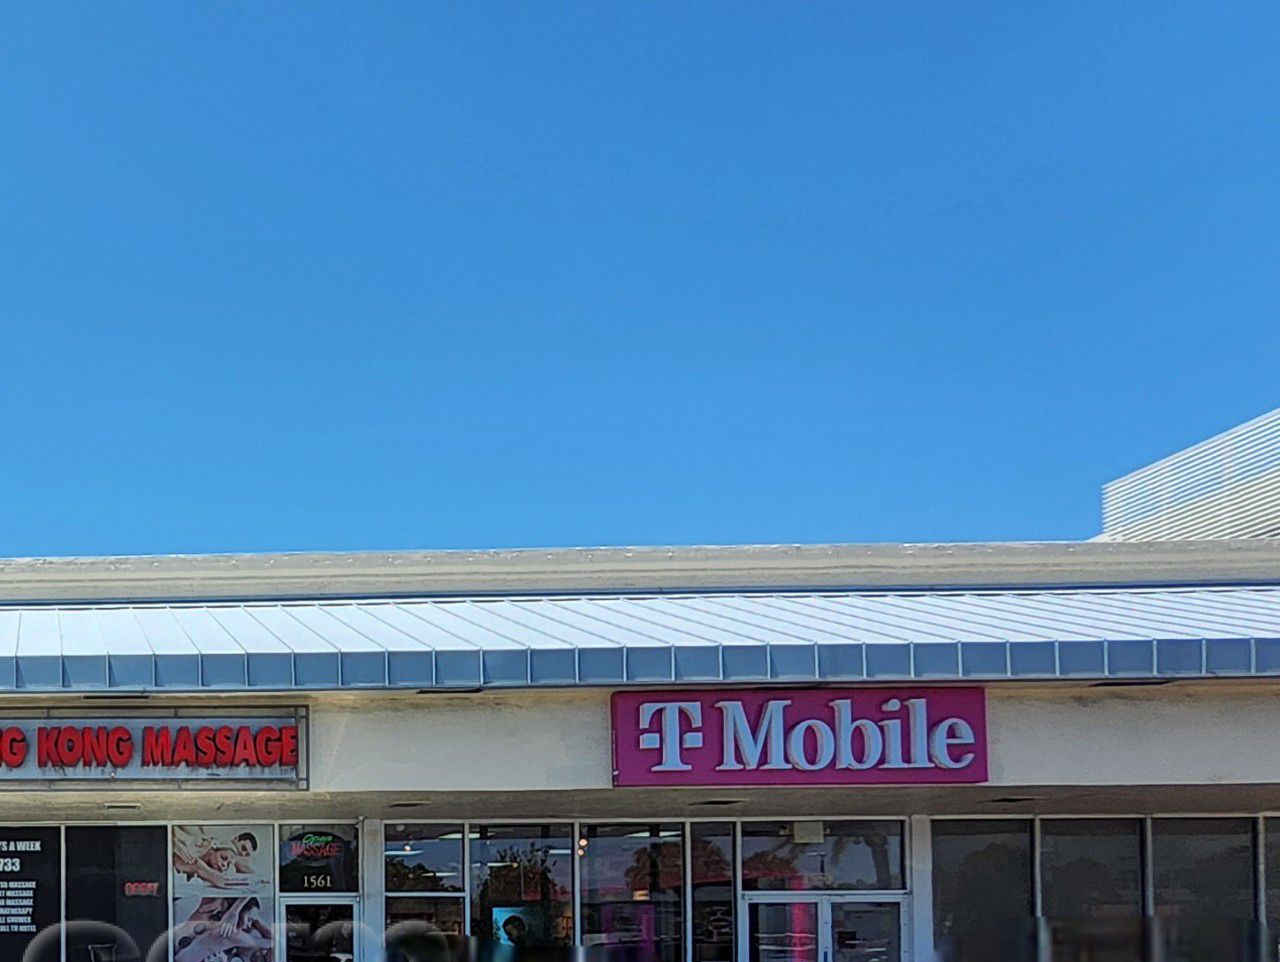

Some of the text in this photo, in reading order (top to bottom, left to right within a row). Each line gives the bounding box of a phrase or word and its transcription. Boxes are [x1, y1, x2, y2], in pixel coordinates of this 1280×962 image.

[36, 725, 134, 768] KONG
[140, 724, 300, 768] MASSAGE
[714, 697, 976, 772] Mobile
[8, 841, 17, 851] A
[17, 841, 42, 851] WEEK
[302, 874, 333, 888] 1561
